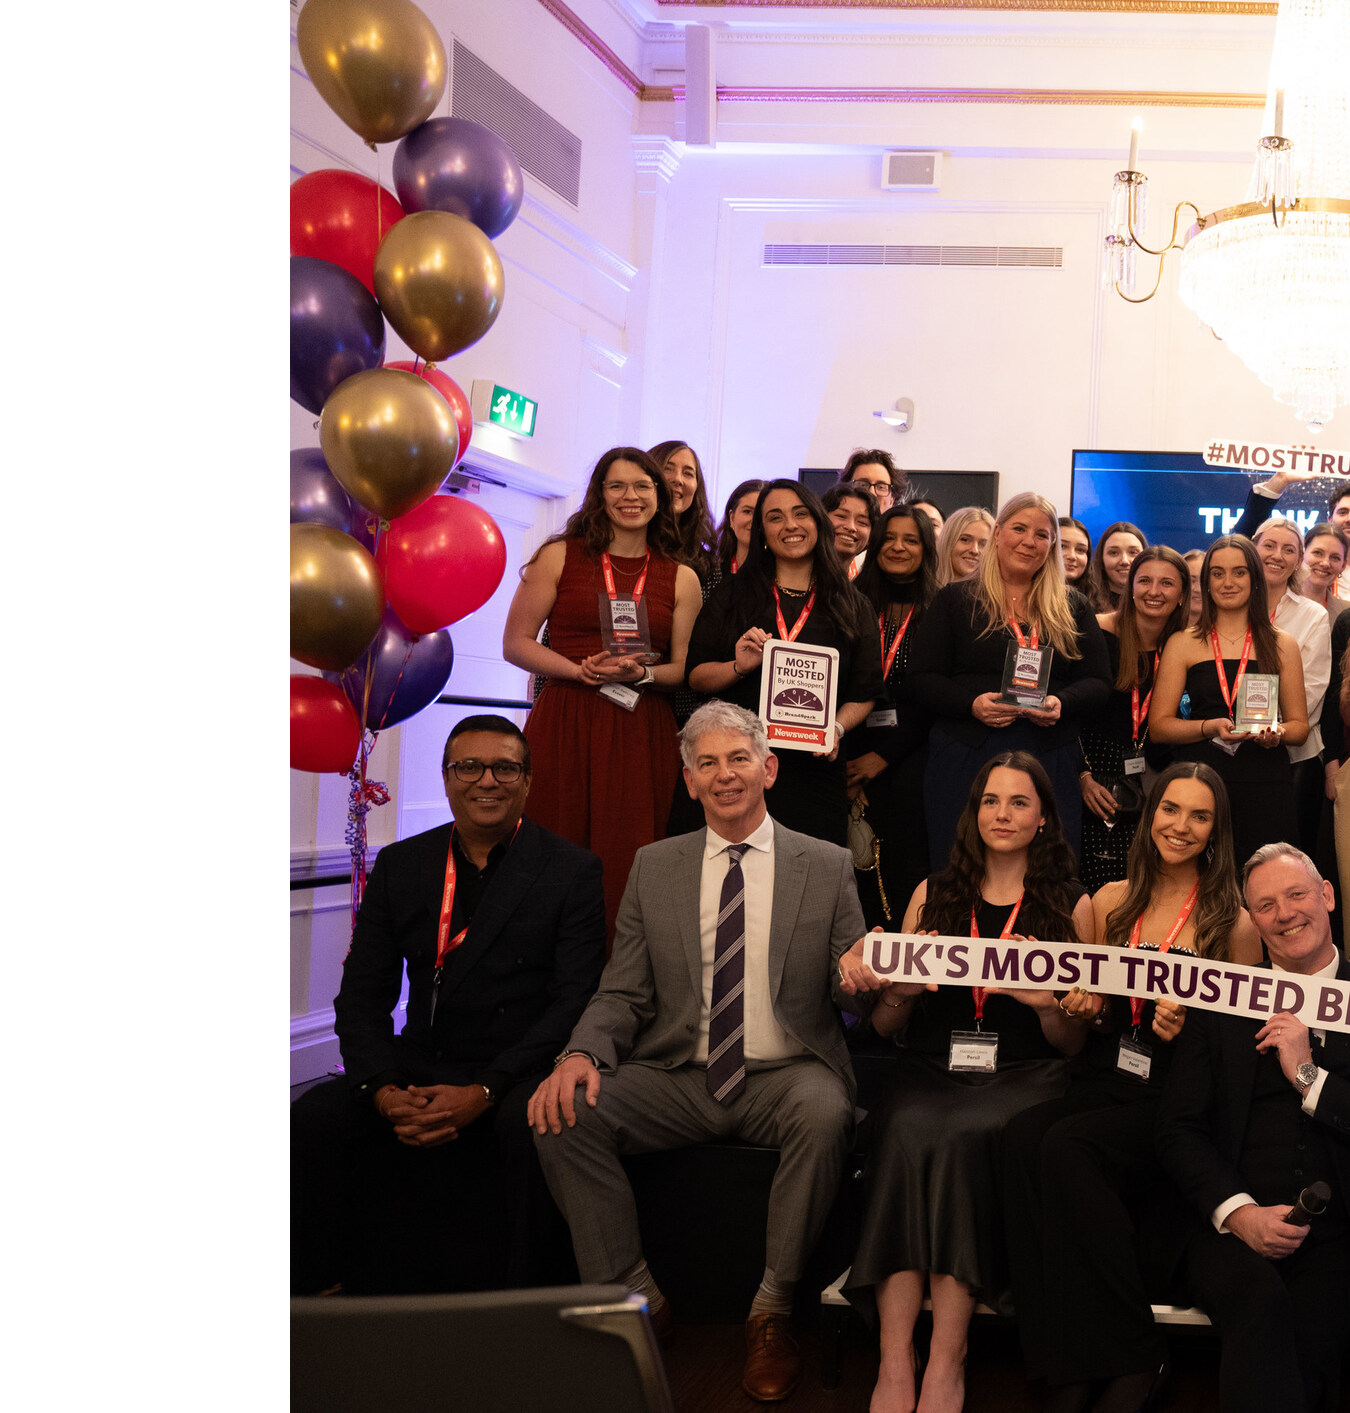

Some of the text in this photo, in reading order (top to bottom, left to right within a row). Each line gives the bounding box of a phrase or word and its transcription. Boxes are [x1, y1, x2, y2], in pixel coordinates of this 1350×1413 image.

[1198, 507, 1320, 534] THNK
[786, 657, 817, 670] MOST
[776, 667, 824, 680] TRUSTED
[777, 678, 824, 690] By UK Shoppers
[774, 728, 818, 740] Newsweek
[1166, 916, 1184, 943] Newsweek
[871, 940, 970, 979] UK'S
[981, 946, 1109, 986] MOST
[1119, 956, 1305, 1015] TRUSTED
